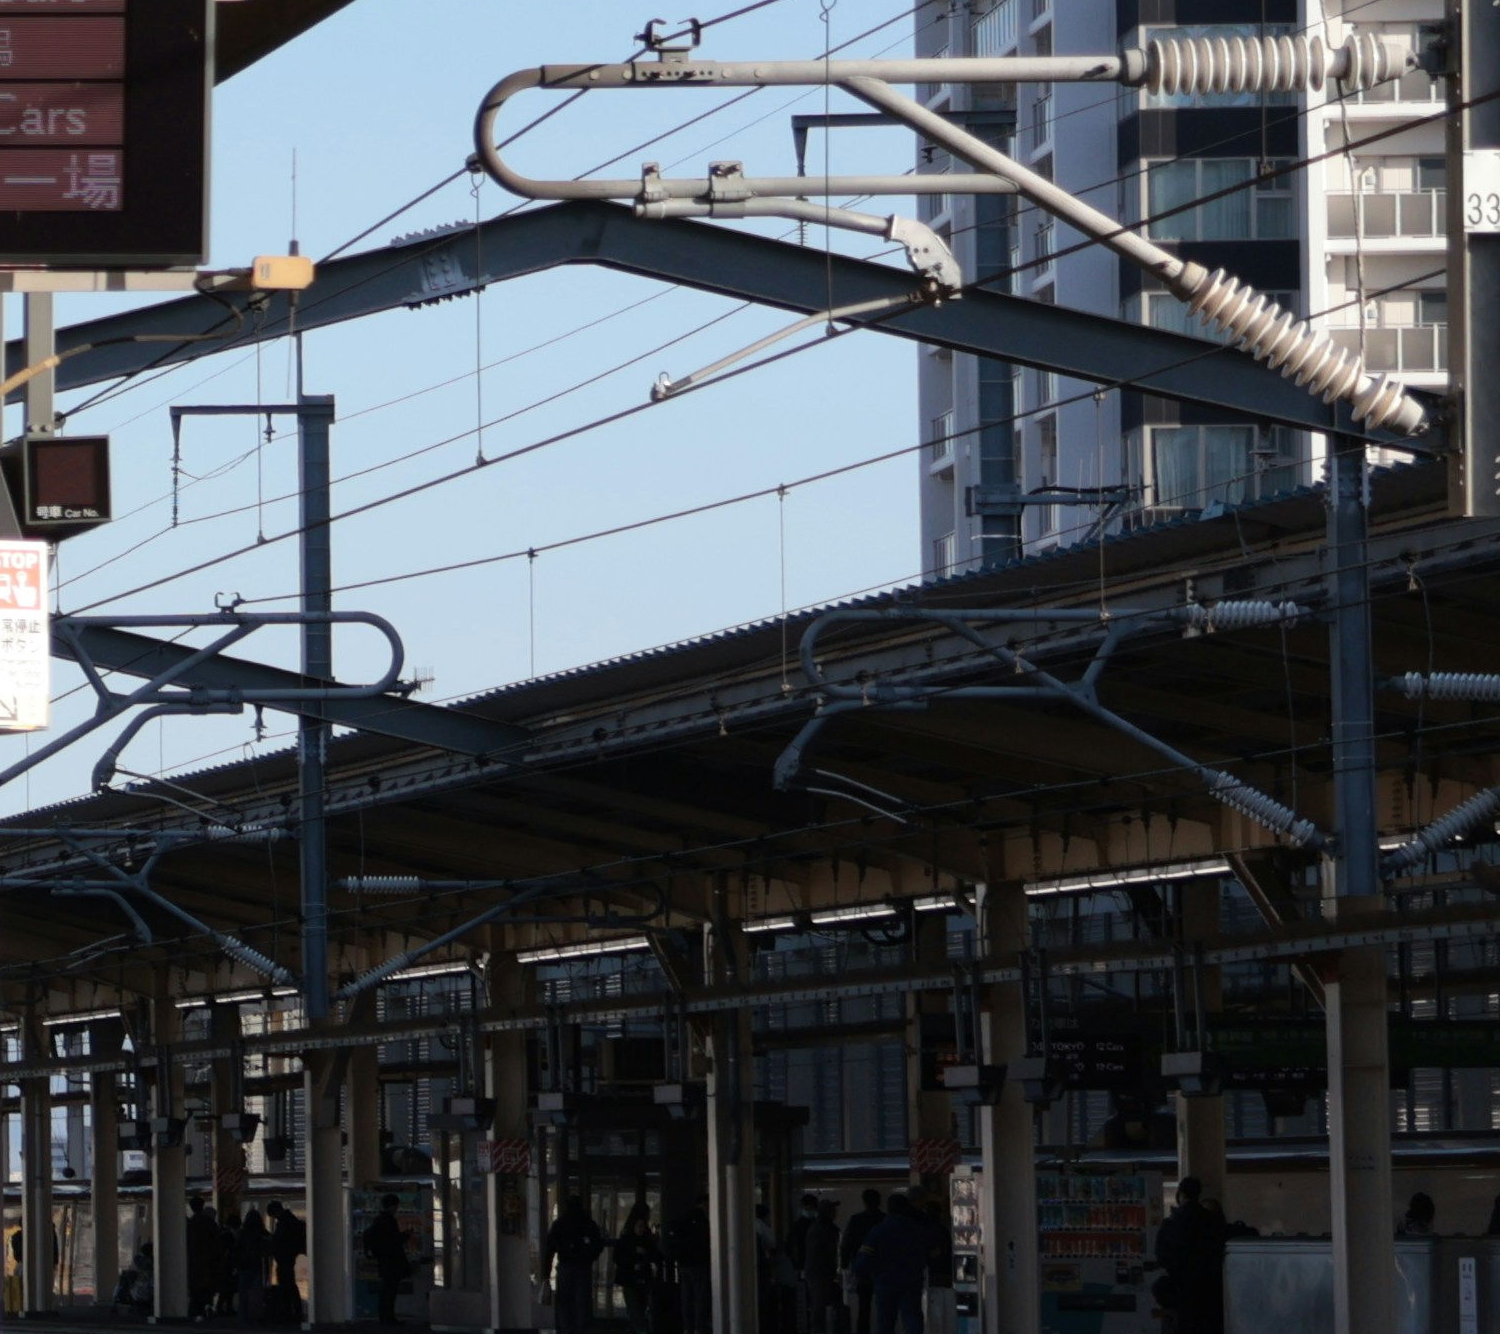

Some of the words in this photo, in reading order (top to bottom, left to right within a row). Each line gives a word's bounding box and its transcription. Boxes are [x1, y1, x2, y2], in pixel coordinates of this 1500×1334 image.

[36, 506, 63, 519] 号車
[64, 509, 81, 518] Car
[83, 509, 99, 518] No.
